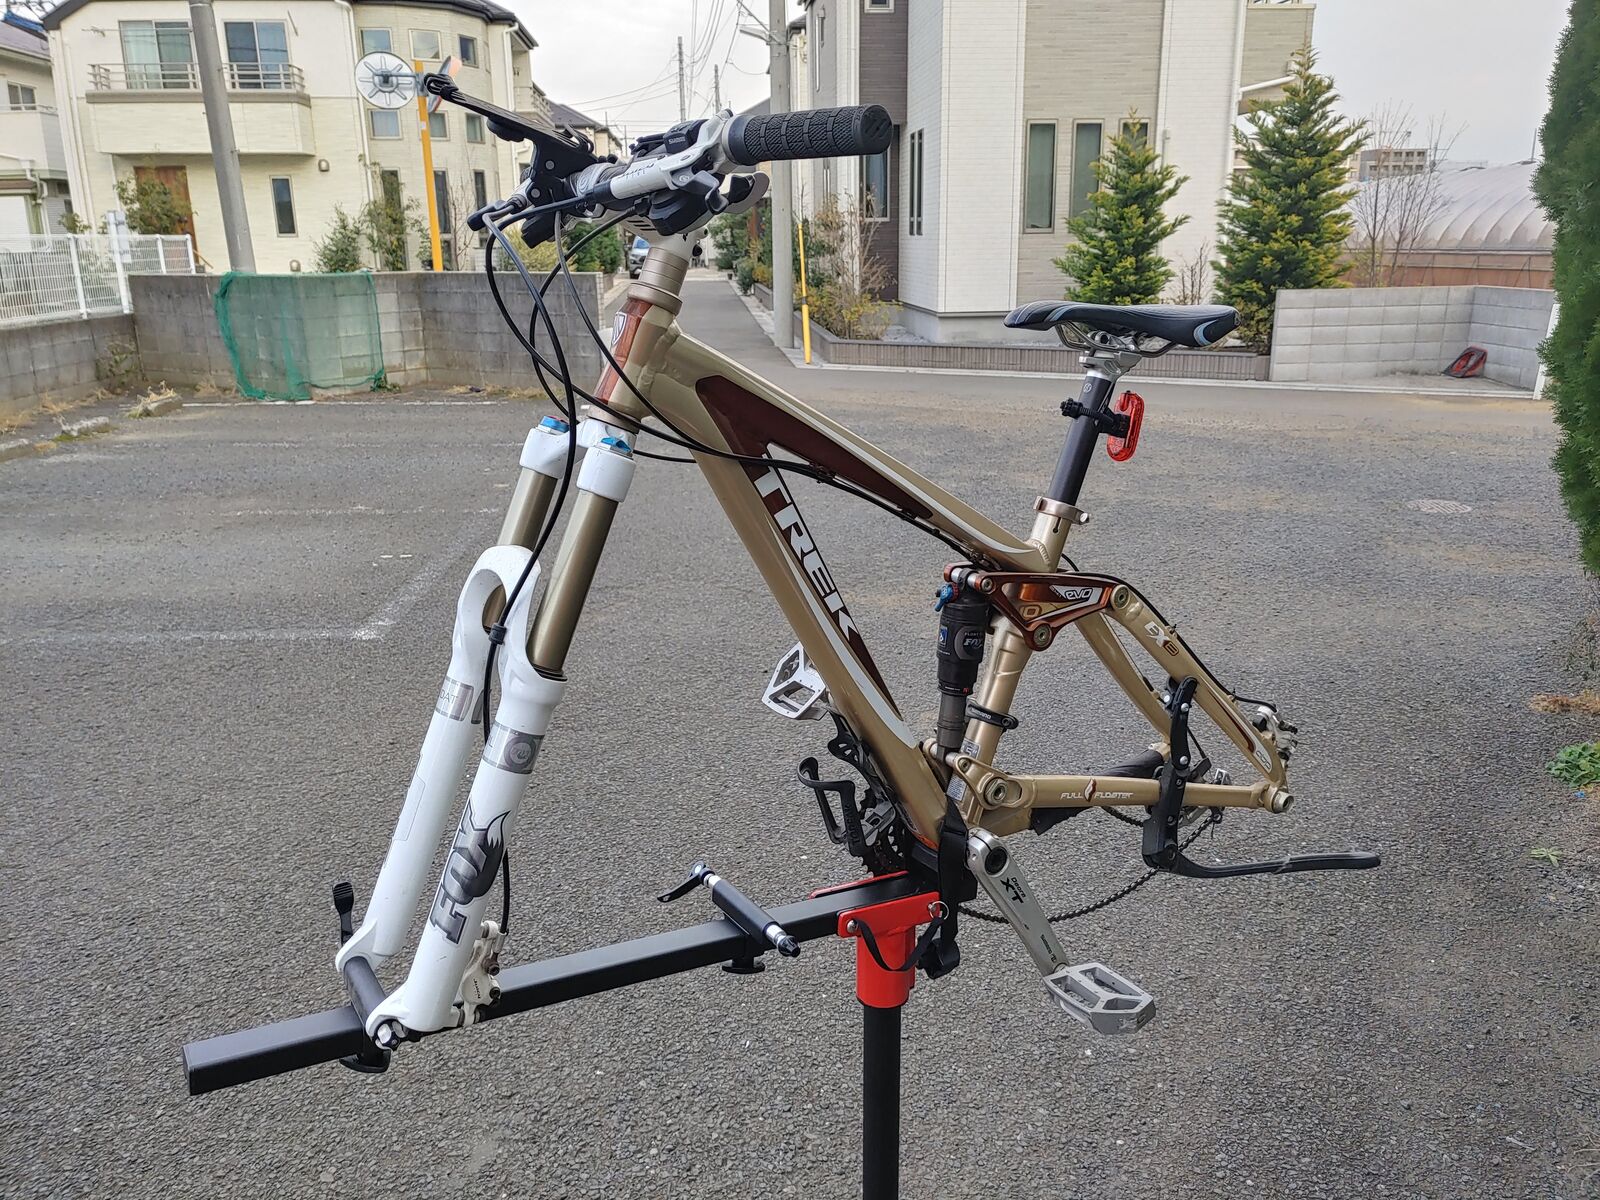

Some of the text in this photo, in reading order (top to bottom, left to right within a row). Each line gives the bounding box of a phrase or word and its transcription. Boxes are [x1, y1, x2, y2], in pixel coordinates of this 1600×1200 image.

[753, 453, 859, 641] TREK
[429, 799, 498, 945] FOX
[1000, 876, 1025, 904] XT
